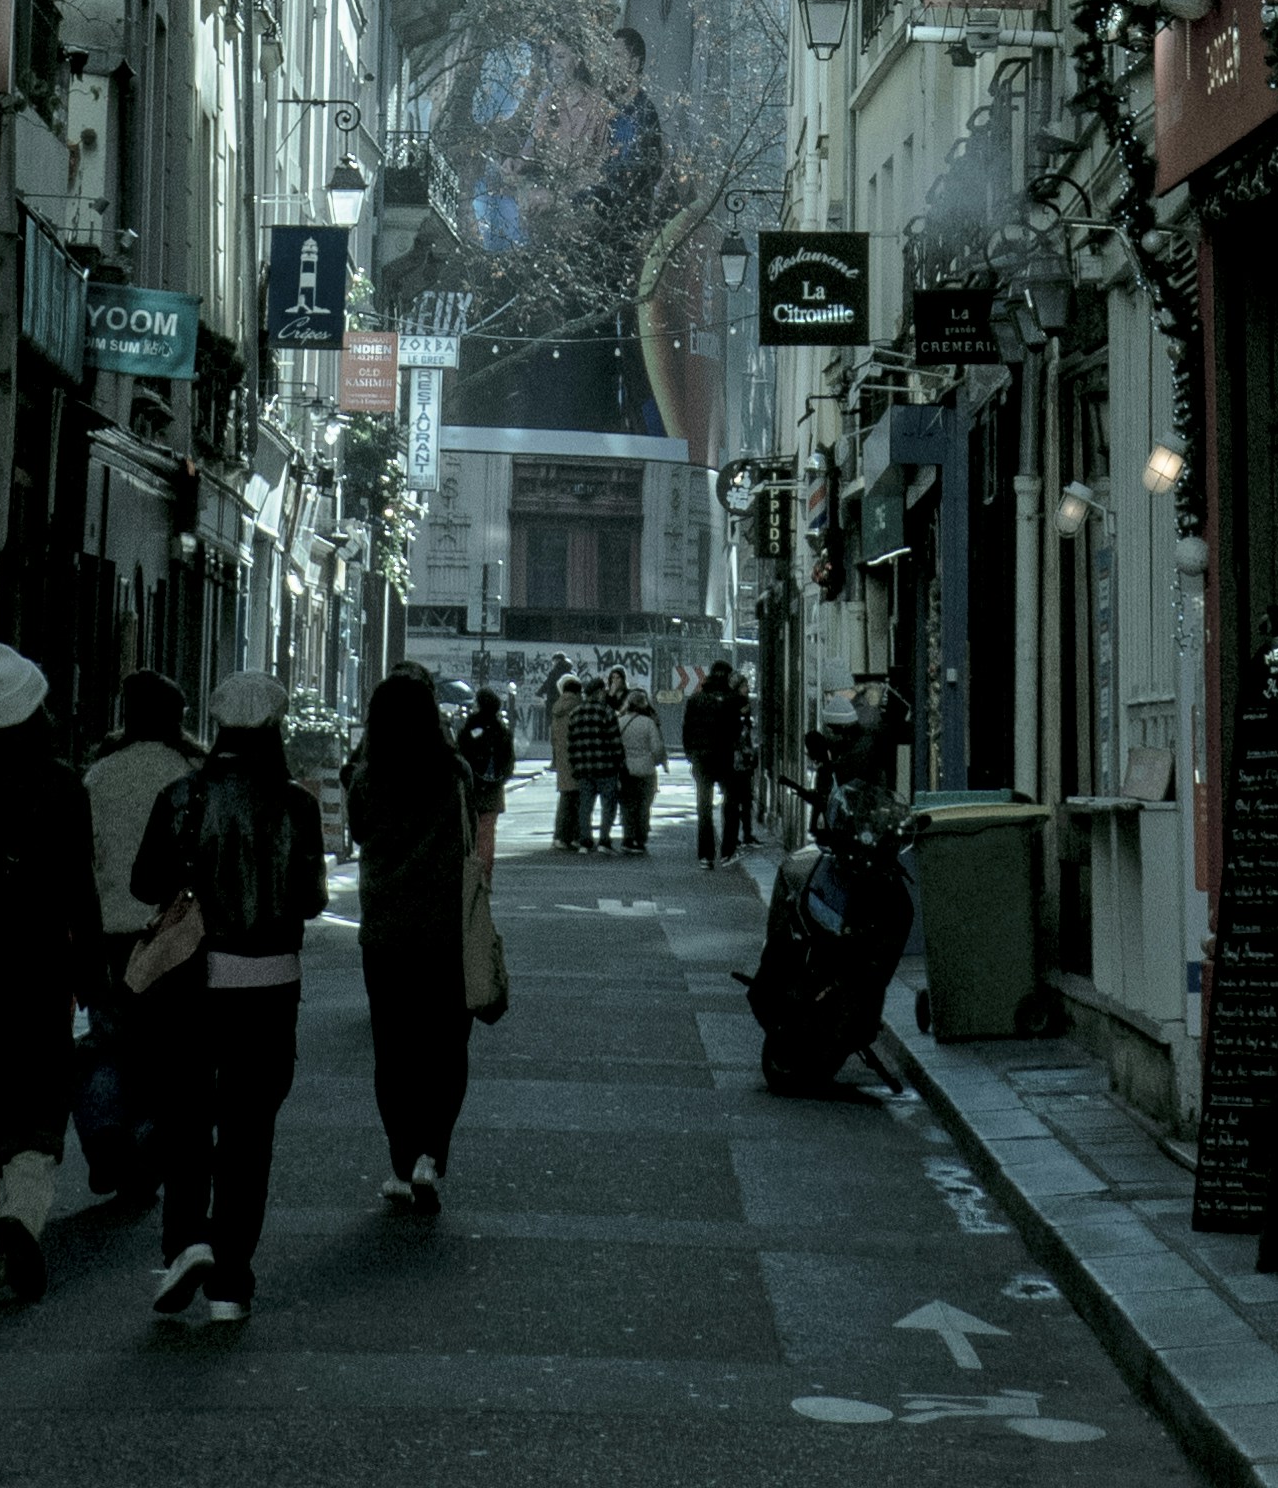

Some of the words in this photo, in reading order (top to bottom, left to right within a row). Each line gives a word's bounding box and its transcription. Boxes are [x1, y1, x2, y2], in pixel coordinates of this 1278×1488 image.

[768, 247, 859, 281] Restaurant
[802, 281, 826, 300] La
[87, 303, 178, 337] YOOM
[773, 303, 855, 324] Citrouille
[951, 308, 969, 320] La
[109, 339, 141, 354] SUM
[348, 344, 392, 354] INDIEN
[399, 337, 455, 352] ZORBA
[921, 341, 997, 353] CREMERI
[408, 356, 418, 364] LE
[421, 356, 445, 365] GREC
[359, 368, 381, 377] OLD
[414, 370, 433, 474] RESTAURANT
